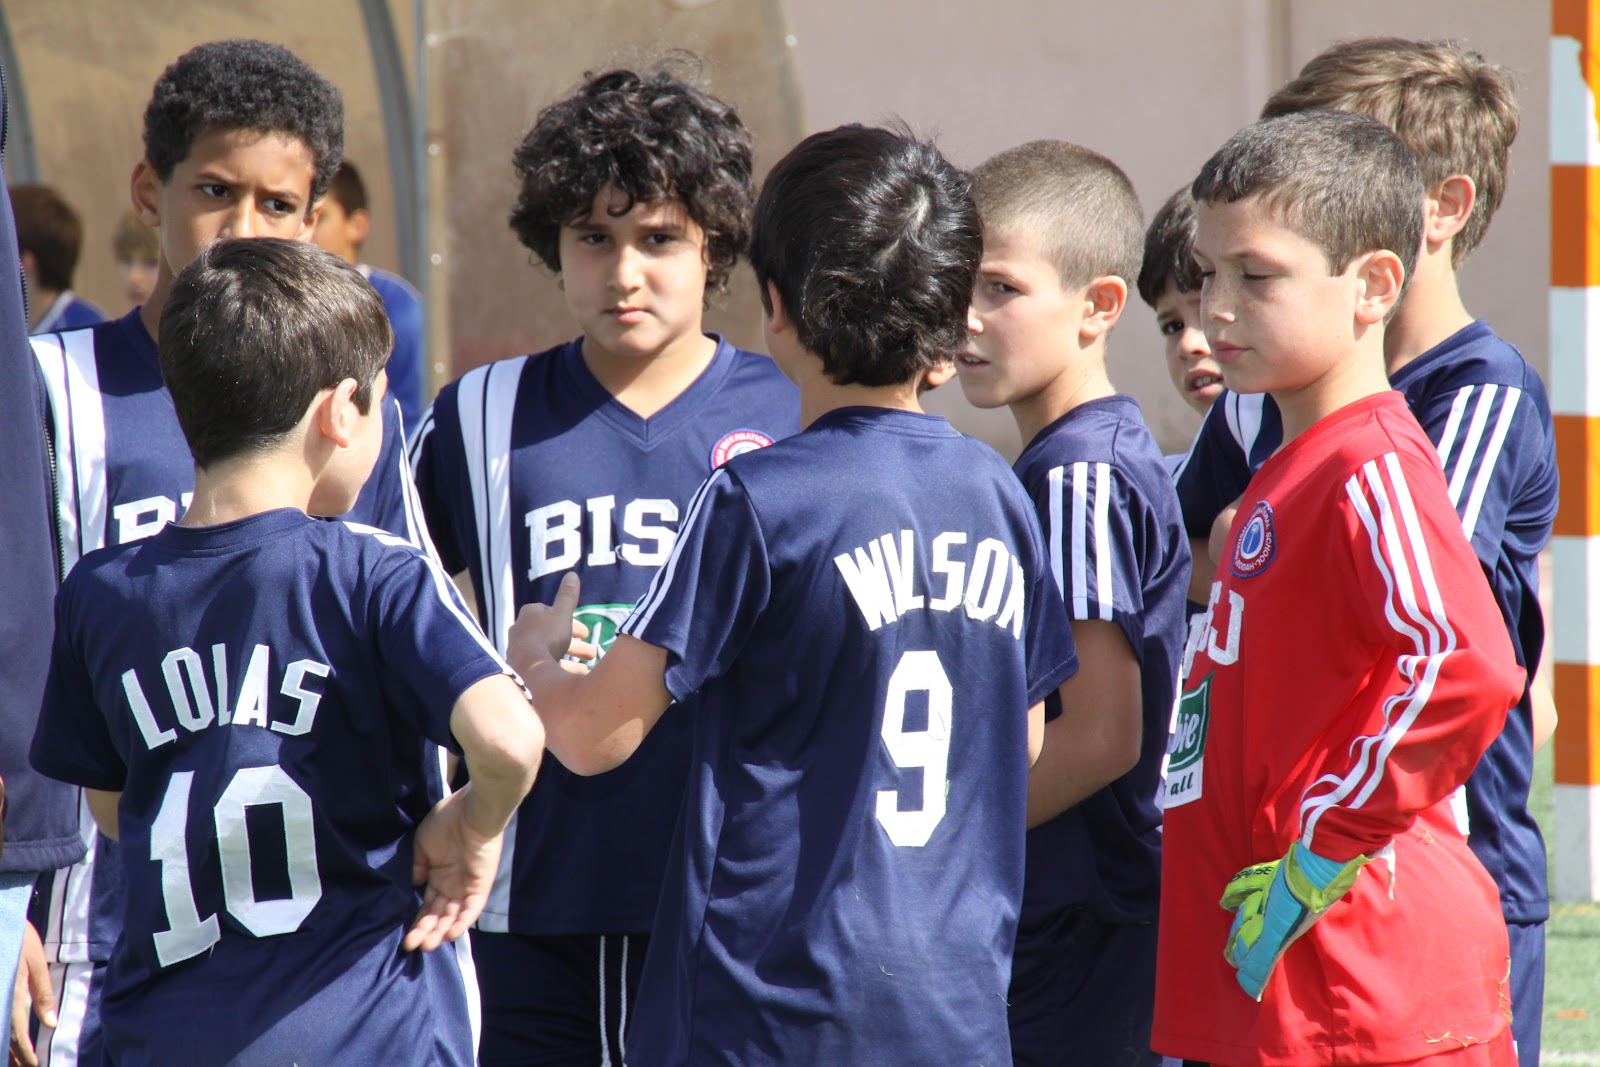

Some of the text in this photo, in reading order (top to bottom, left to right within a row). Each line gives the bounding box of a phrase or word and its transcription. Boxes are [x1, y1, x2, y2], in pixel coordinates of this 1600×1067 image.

[834, 529, 1025, 641] WILSON
[121, 643, 331, 750] LOLAS
[875, 651, 953, 847] 9
[150, 764, 322, 968] 10
